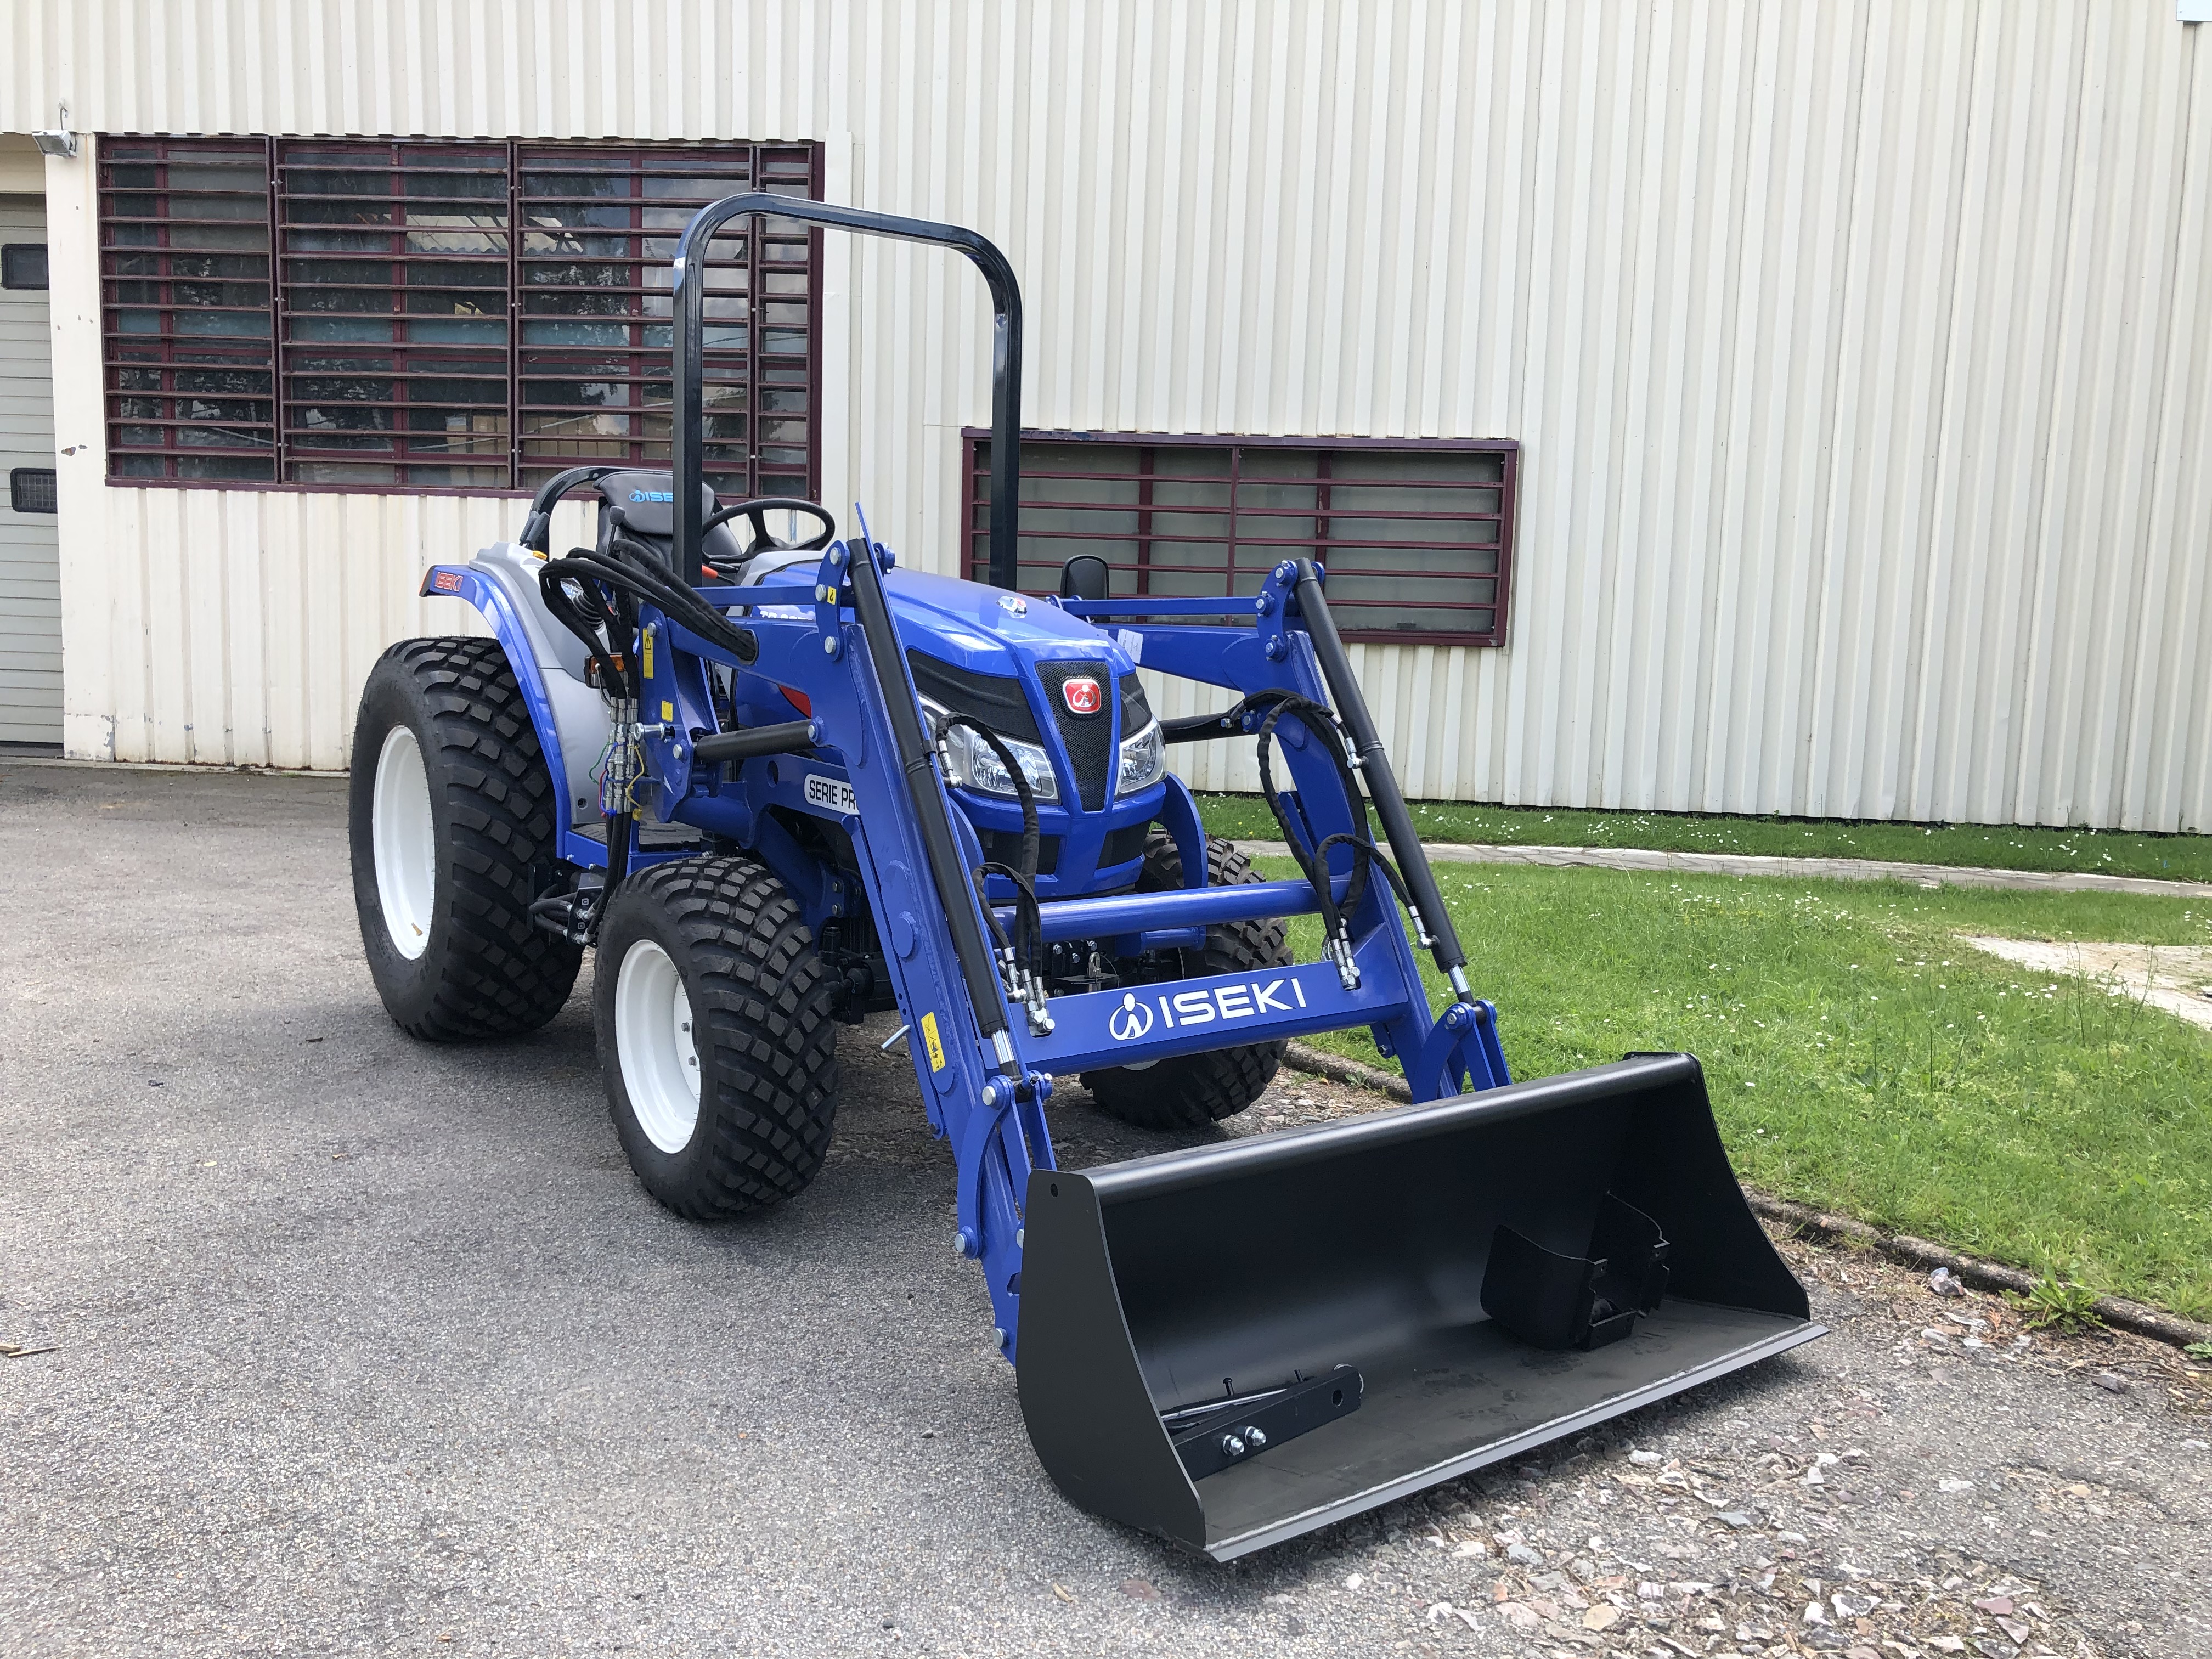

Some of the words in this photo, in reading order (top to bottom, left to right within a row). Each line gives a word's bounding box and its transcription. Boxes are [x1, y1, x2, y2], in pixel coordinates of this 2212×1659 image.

[644, 491, 673, 502] ISE
[435, 572, 463, 591] ISEKI
[809, 780, 838, 805] SERIE
[841, 787, 859, 810] PR
[1158, 977, 1307, 1028] ISEKI
